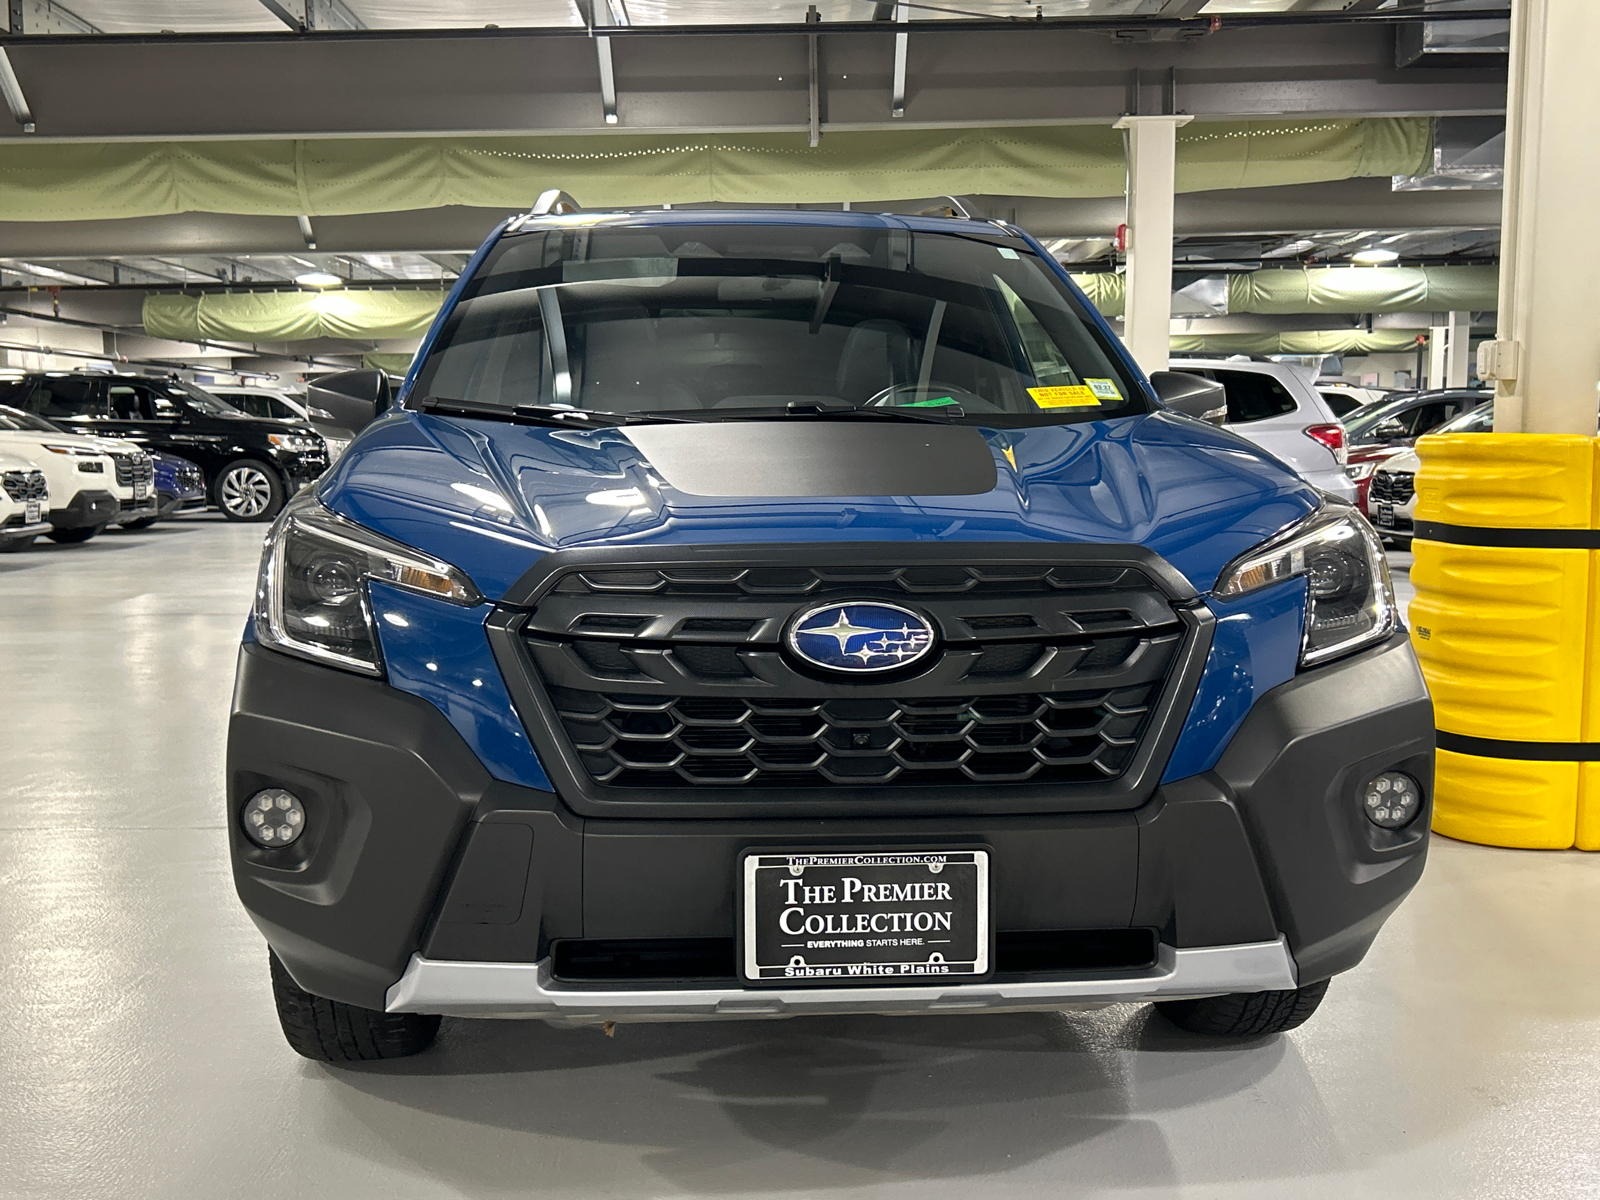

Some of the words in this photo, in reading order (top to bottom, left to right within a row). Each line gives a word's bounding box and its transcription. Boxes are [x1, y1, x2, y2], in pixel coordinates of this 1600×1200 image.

[779, 878, 837, 905] THE
[841, 877, 953, 903] PREMIER
[779, 907, 953, 935] COLLECTION
[807, 939, 865, 949] EVERYTHING
[866, 938, 898, 947] STARTS
[899, 937, 925, 946] HERE.
[784, 966, 842, 977] Subaru
[847, 965, 894, 975] White
[900, 963, 949, 974] Plains
